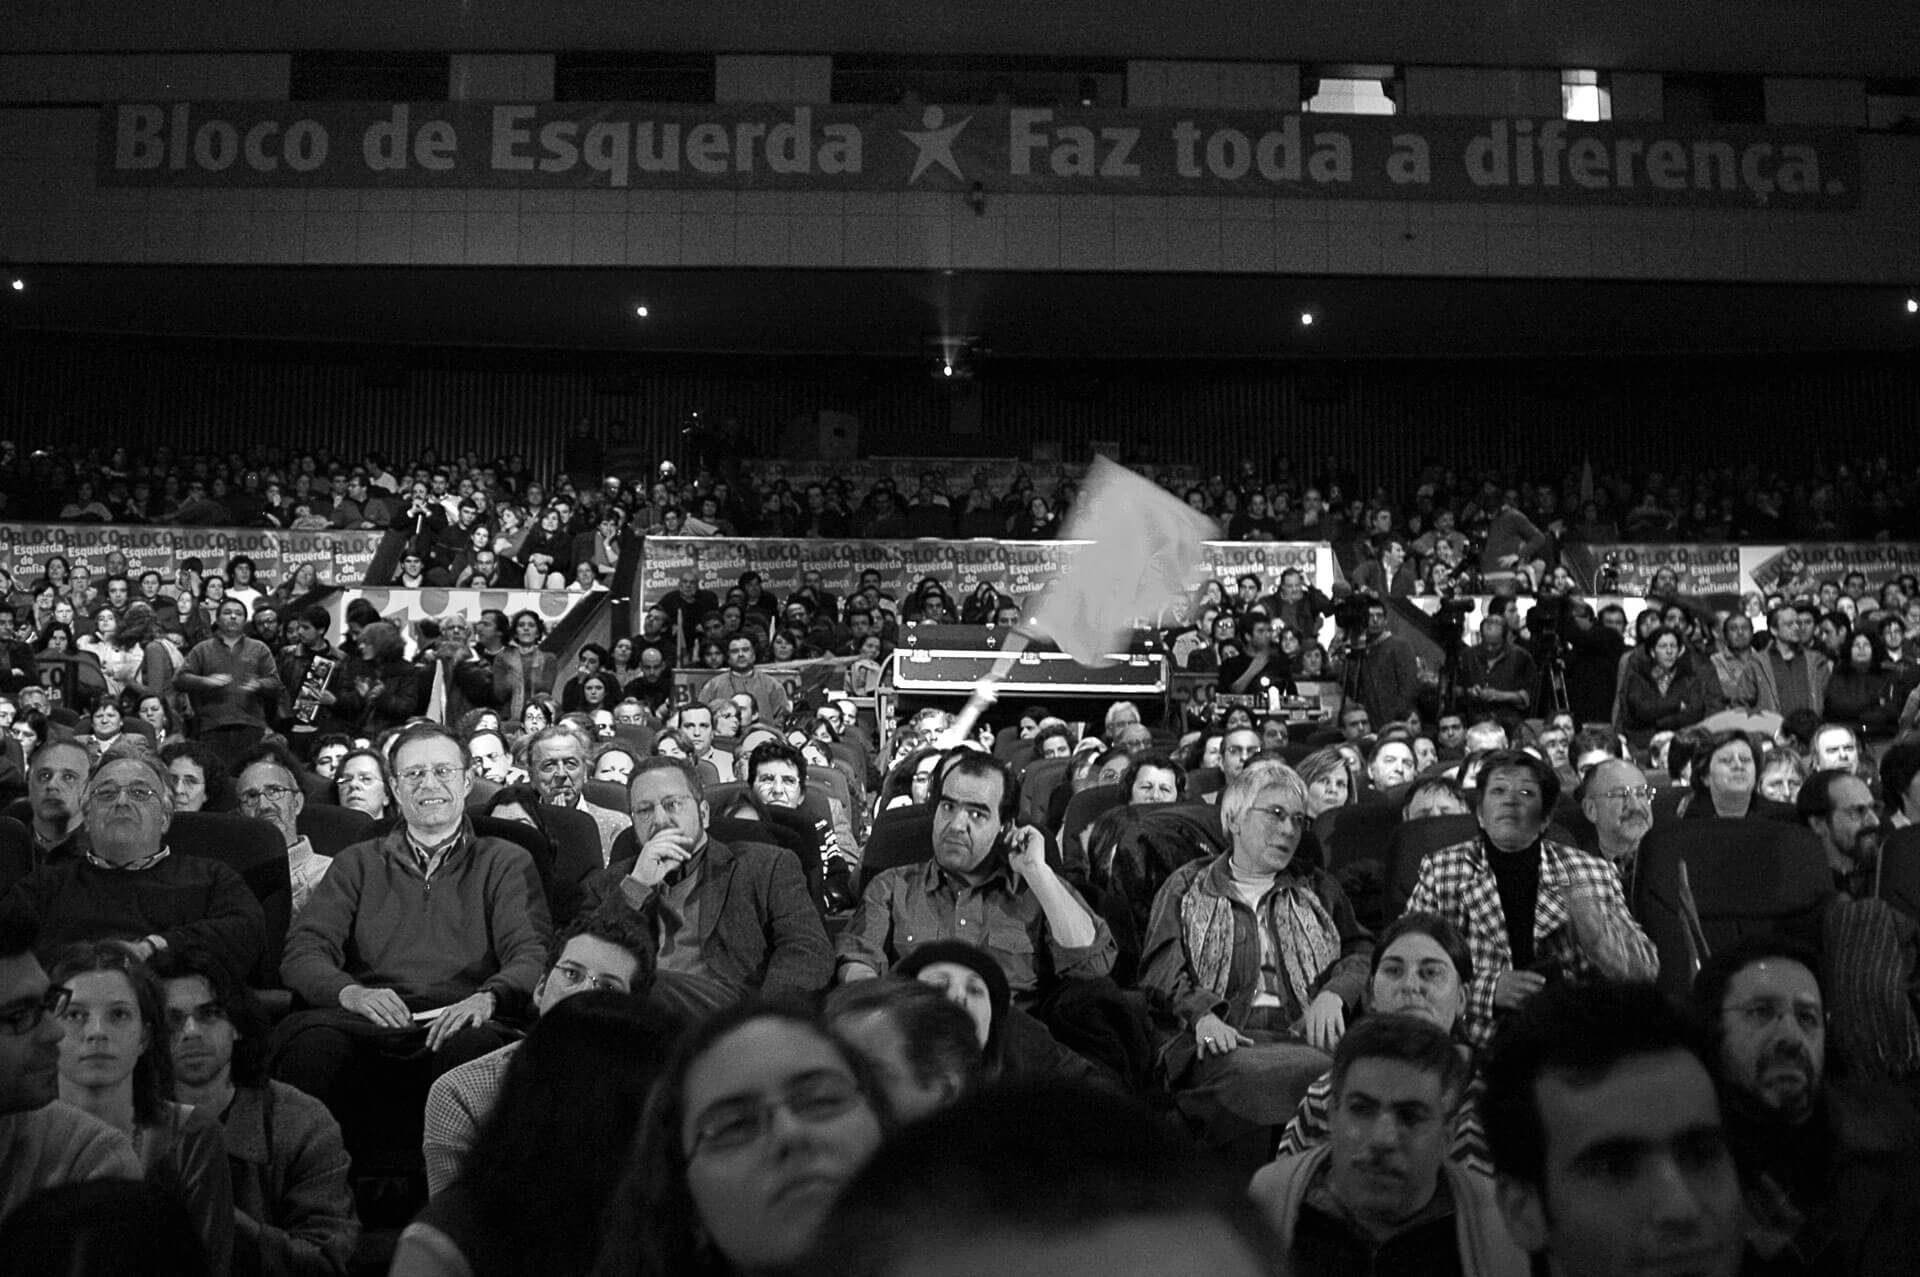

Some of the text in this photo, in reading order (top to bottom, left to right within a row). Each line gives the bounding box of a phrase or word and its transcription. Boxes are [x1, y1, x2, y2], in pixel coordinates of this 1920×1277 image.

[115, 104, 1846, 205] Bloco de Esquerda Faz toda a diferença.
[12, 528, 66, 545] BLOCO
[66, 530, 120, 547] BLOCO
[120, 531, 174, 548] BLOCO
[174, 533, 227, 550] BLOCO
[13, 542, 63, 556] Esquerda
[67, 544, 117, 558] Esquerda
[121, 545, 171, 558] Esquerda
[280, 537, 332, 553] BLOCO
[229, 549, 278, 560] Euerda
[282, 550, 331, 563] Esquerda
[335, 551, 376, 565] Esquer
[748, 544, 800, 561] BLOCO
[1007, 549, 1056, 565] BLOC
[1213, 548, 1266, 566] BLOCO
[20, 555, 33, 565] de
[75, 556, 88, 566] de
[129, 558, 142, 568] de
[646, 556, 694, 569] Esquerda
[698, 557, 746, 571] Esquerda
[750, 559, 798, 571] Esquerda
[802, 559, 850, 572] Esquerda
[13, 564, 46, 575] Confia
[342, 563, 355, 574] de
[905, 560, 953, 574] Esquerda
[958, 560, 1005, 574] Esquerda
[1009, 561, 1057, 575] Esquerda
[1216, 562, 1264, 576] Esquerda
[653, 569, 665, 579] de
[705, 569, 718, 580] de
[965, 573, 977, 583] de
[1016, 574, 1029, 585] de
[646, 578, 680, 588] Confia
[1010, 582, 1044, 594] Confia
